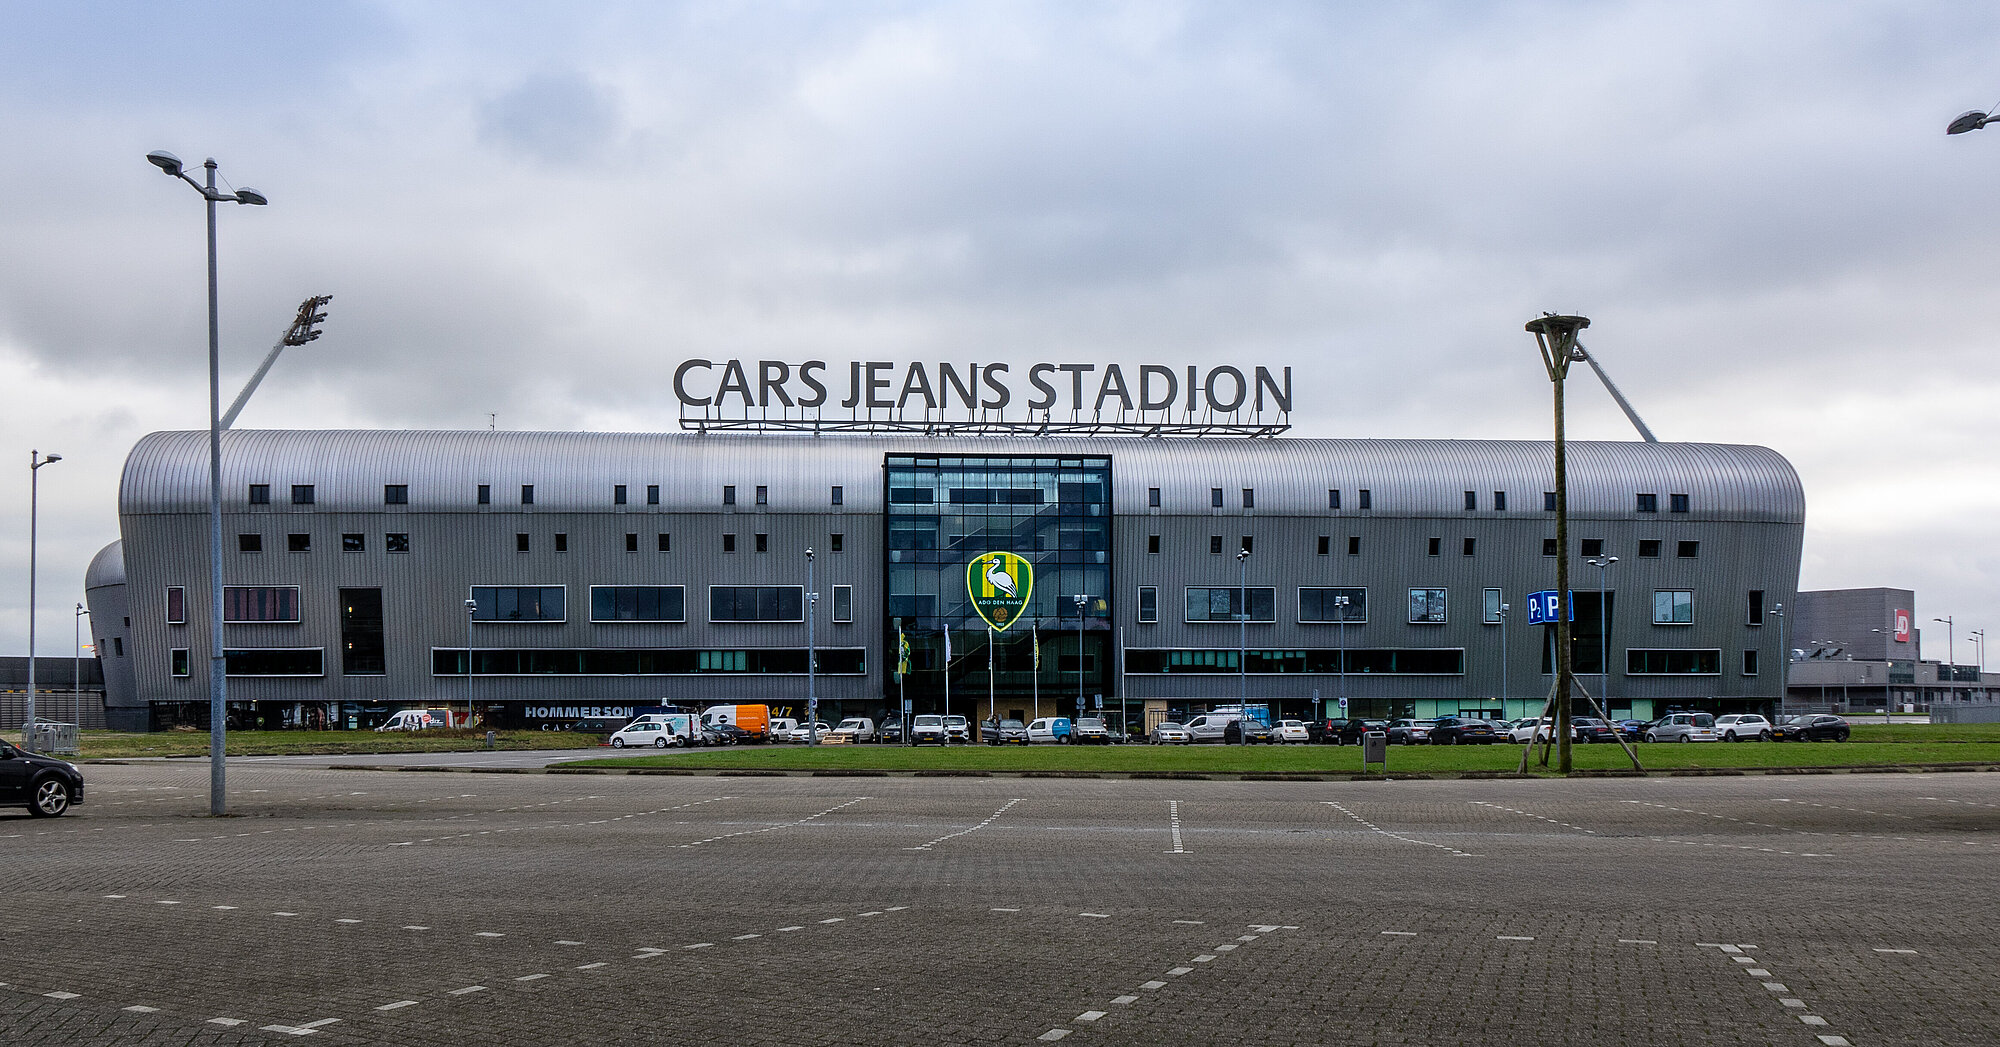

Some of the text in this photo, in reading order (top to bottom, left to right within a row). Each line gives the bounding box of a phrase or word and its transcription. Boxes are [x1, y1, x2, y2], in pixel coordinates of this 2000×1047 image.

[673, 359, 1292, 413] CARS JEANS STADION
[525, 706, 634, 718] HOMMERSON
